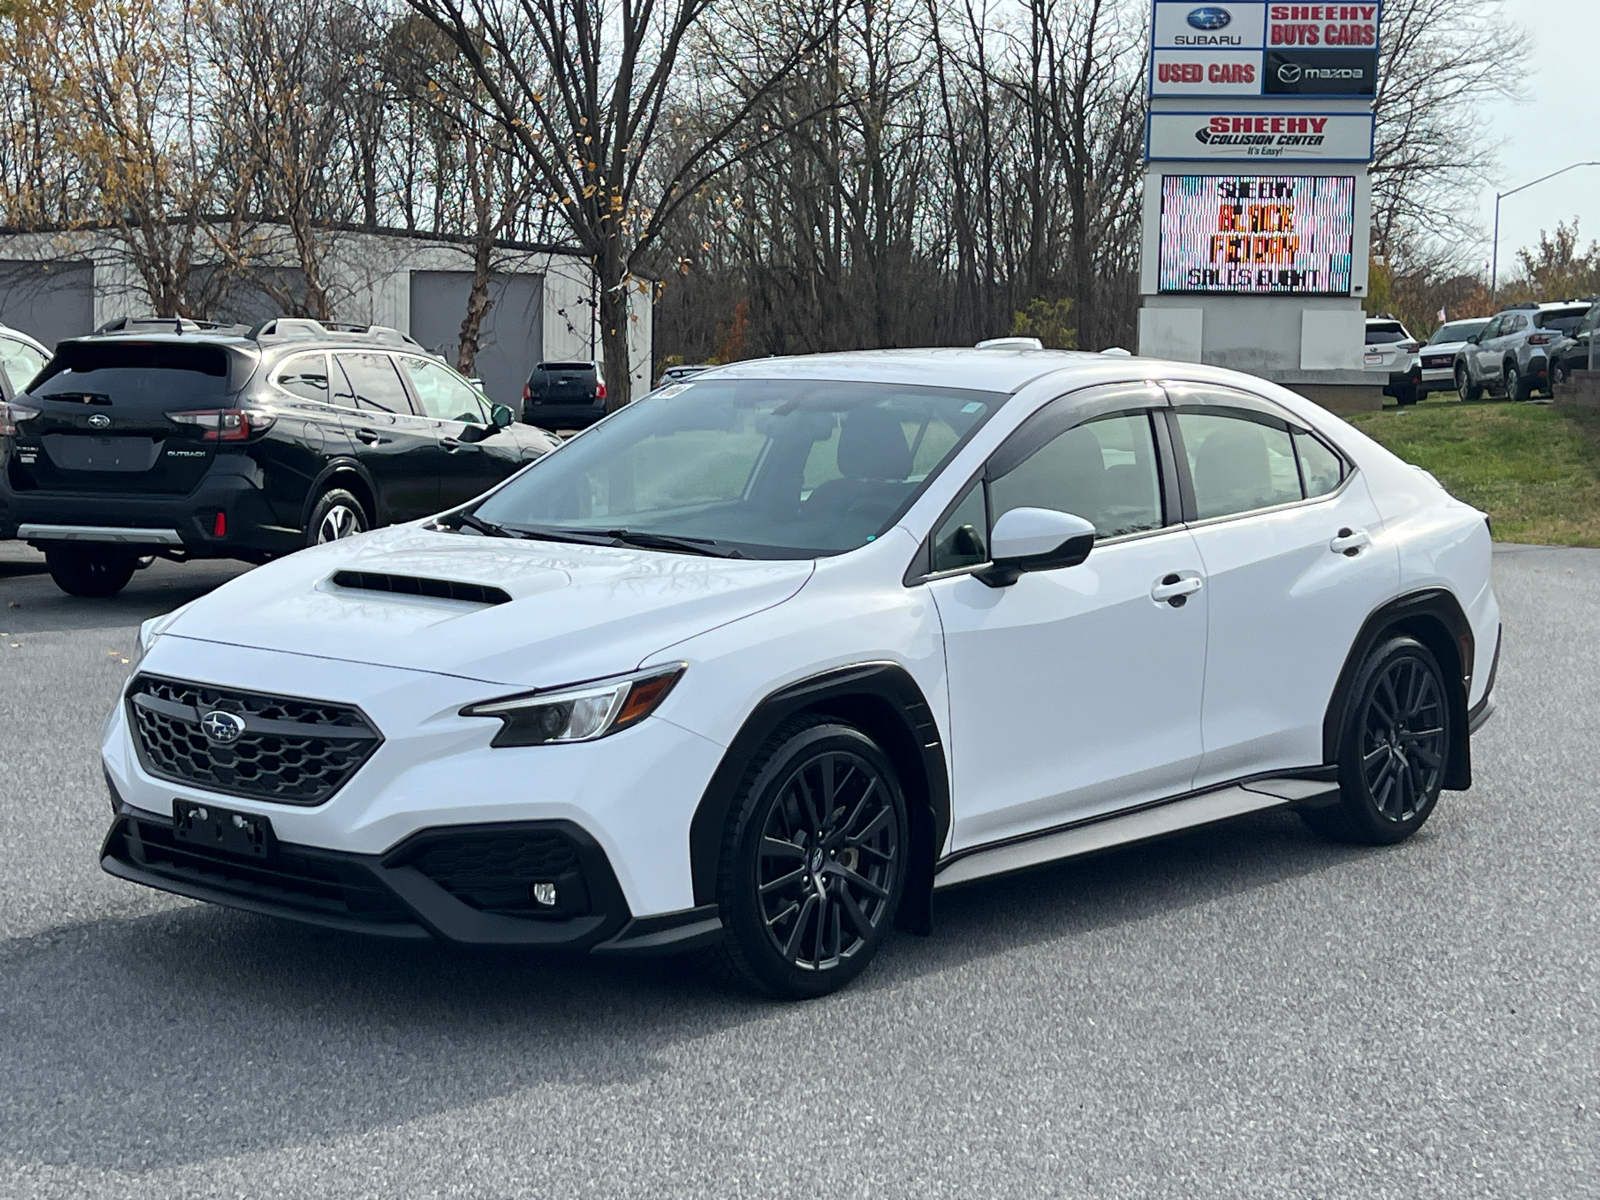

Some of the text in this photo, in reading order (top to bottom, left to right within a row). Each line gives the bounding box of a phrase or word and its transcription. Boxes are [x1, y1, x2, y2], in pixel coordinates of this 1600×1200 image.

[1271, 6, 1376, 20] SHEEHY
[1174, 35, 1242, 45] SUBARU
[1271, 24, 1375, 45] BUYS CARS
[1158, 63, 1255, 83] USED CARS
[1209, 117, 1328, 133] SHEEHY
[1209, 135, 1325, 145] COLLISION CENTER
[1247, 146, 1283, 157] It's Easy!
